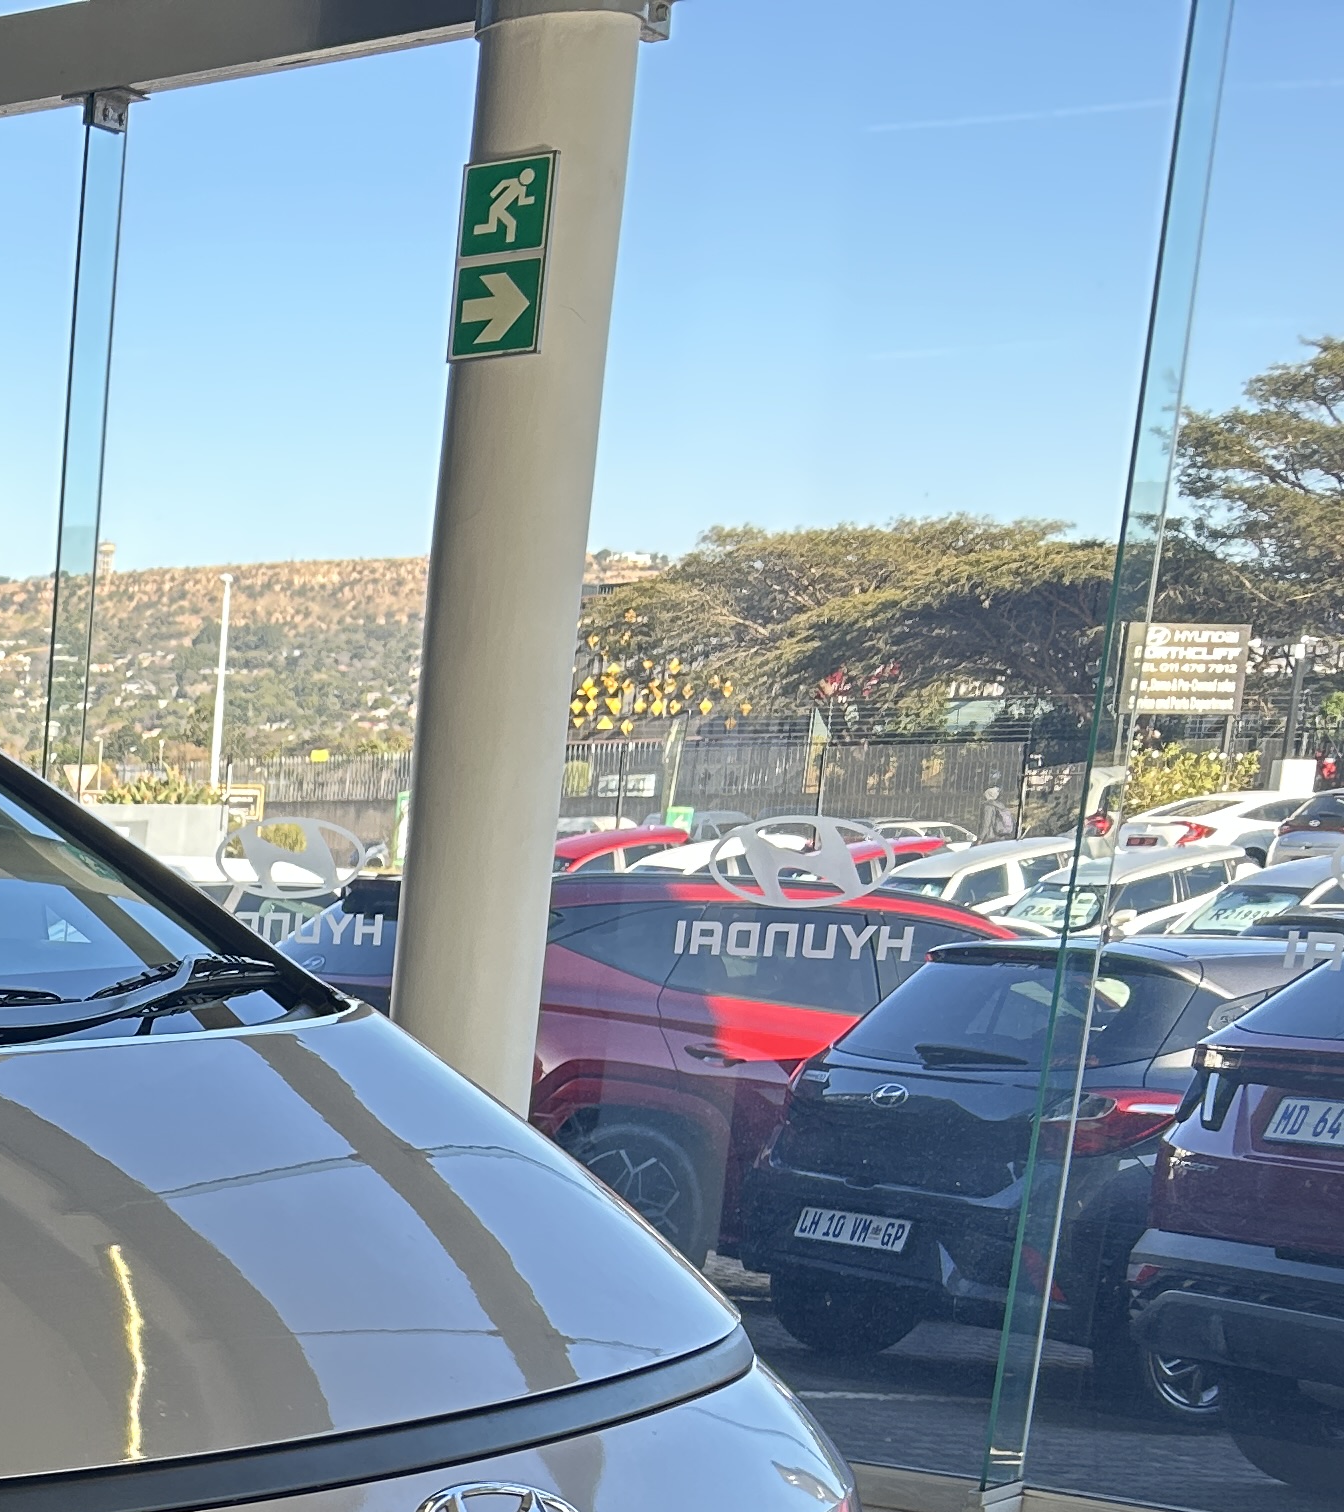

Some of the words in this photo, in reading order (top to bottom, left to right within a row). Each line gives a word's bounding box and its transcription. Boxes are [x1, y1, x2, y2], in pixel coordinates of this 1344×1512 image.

[1273, 1103, 1311, 1136] MD
[798, 1209, 824, 1236] LH
[821, 1212, 847, 1239] 10
[849, 1216, 873, 1243] VM
[880, 1222, 906, 1248] GP
